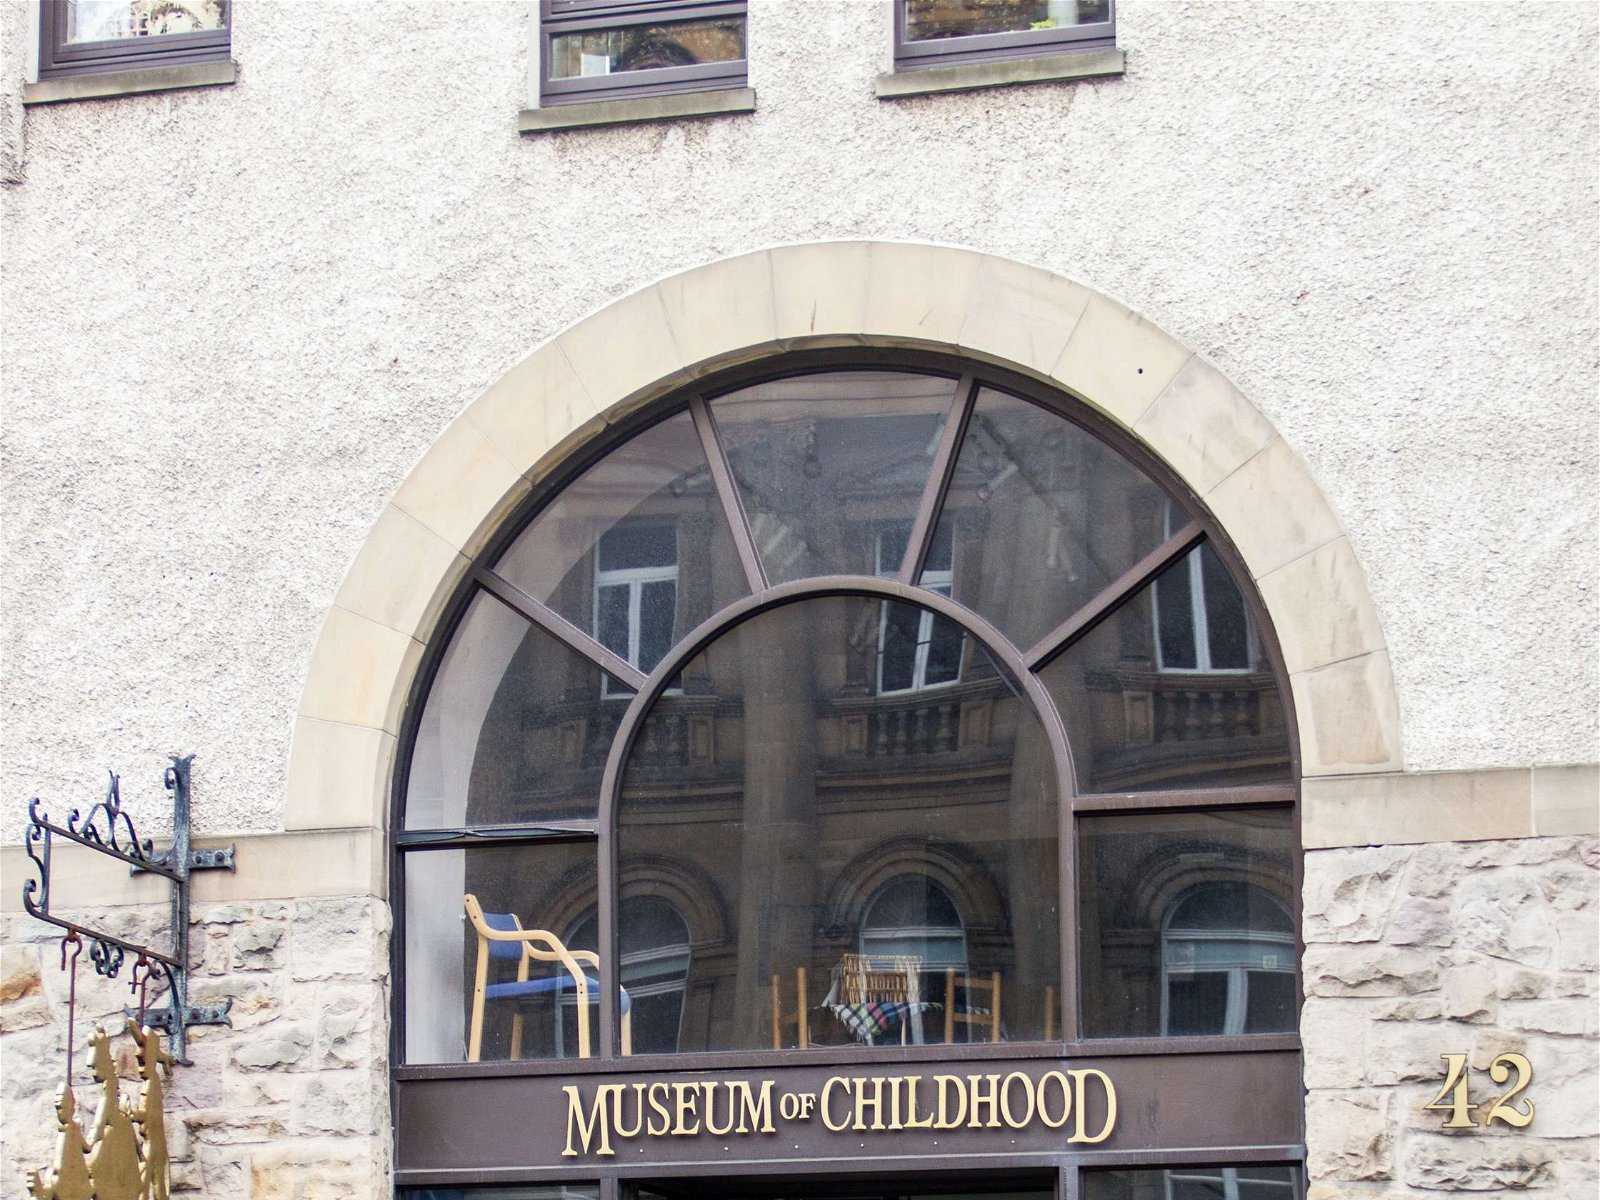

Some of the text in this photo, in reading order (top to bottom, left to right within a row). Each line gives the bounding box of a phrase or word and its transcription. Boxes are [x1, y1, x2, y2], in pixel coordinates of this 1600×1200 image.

[561, 1068, 1117, 1156] MUSEUM OF CHILDHOOD
[1423, 1052, 1534, 1128] 42
